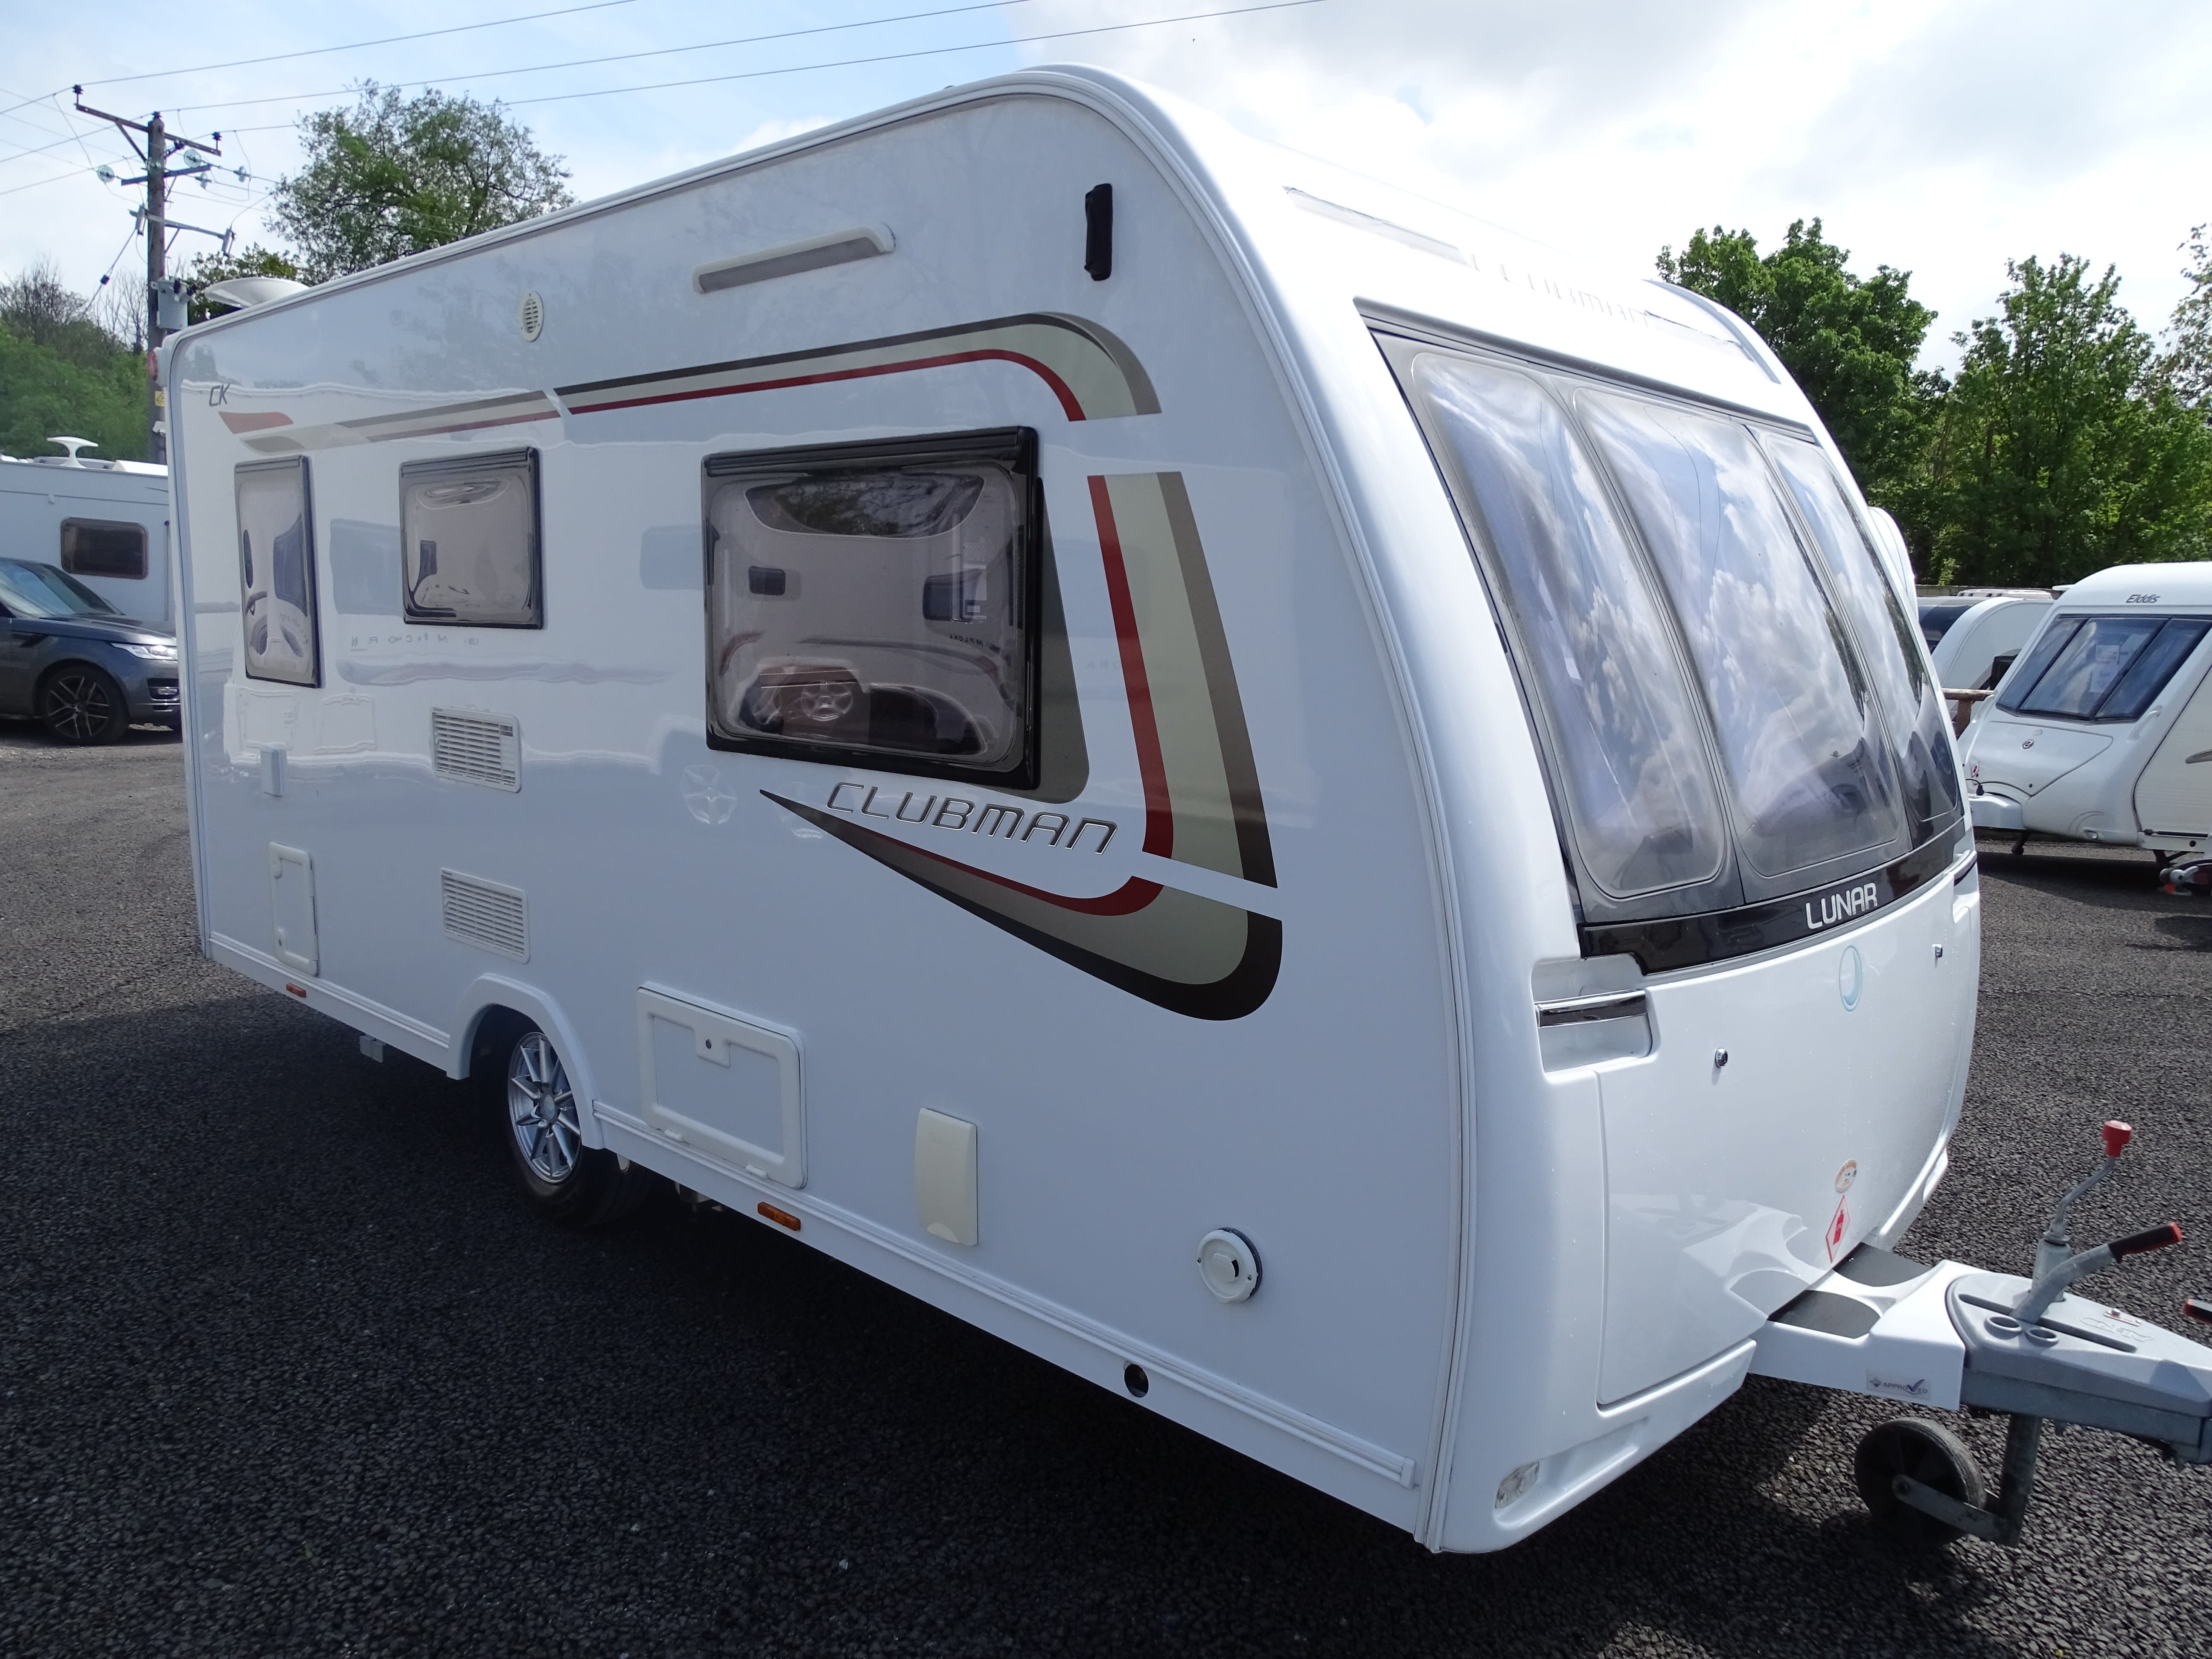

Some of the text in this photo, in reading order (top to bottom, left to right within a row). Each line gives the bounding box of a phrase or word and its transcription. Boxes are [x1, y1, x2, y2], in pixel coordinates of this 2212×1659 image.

[209, 383, 231, 407] CK
[2125, 594, 2161, 603] Elddis
[826, 782, 1118, 856] CLUBMAN
[1806, 882, 1877, 929] LUNAR
